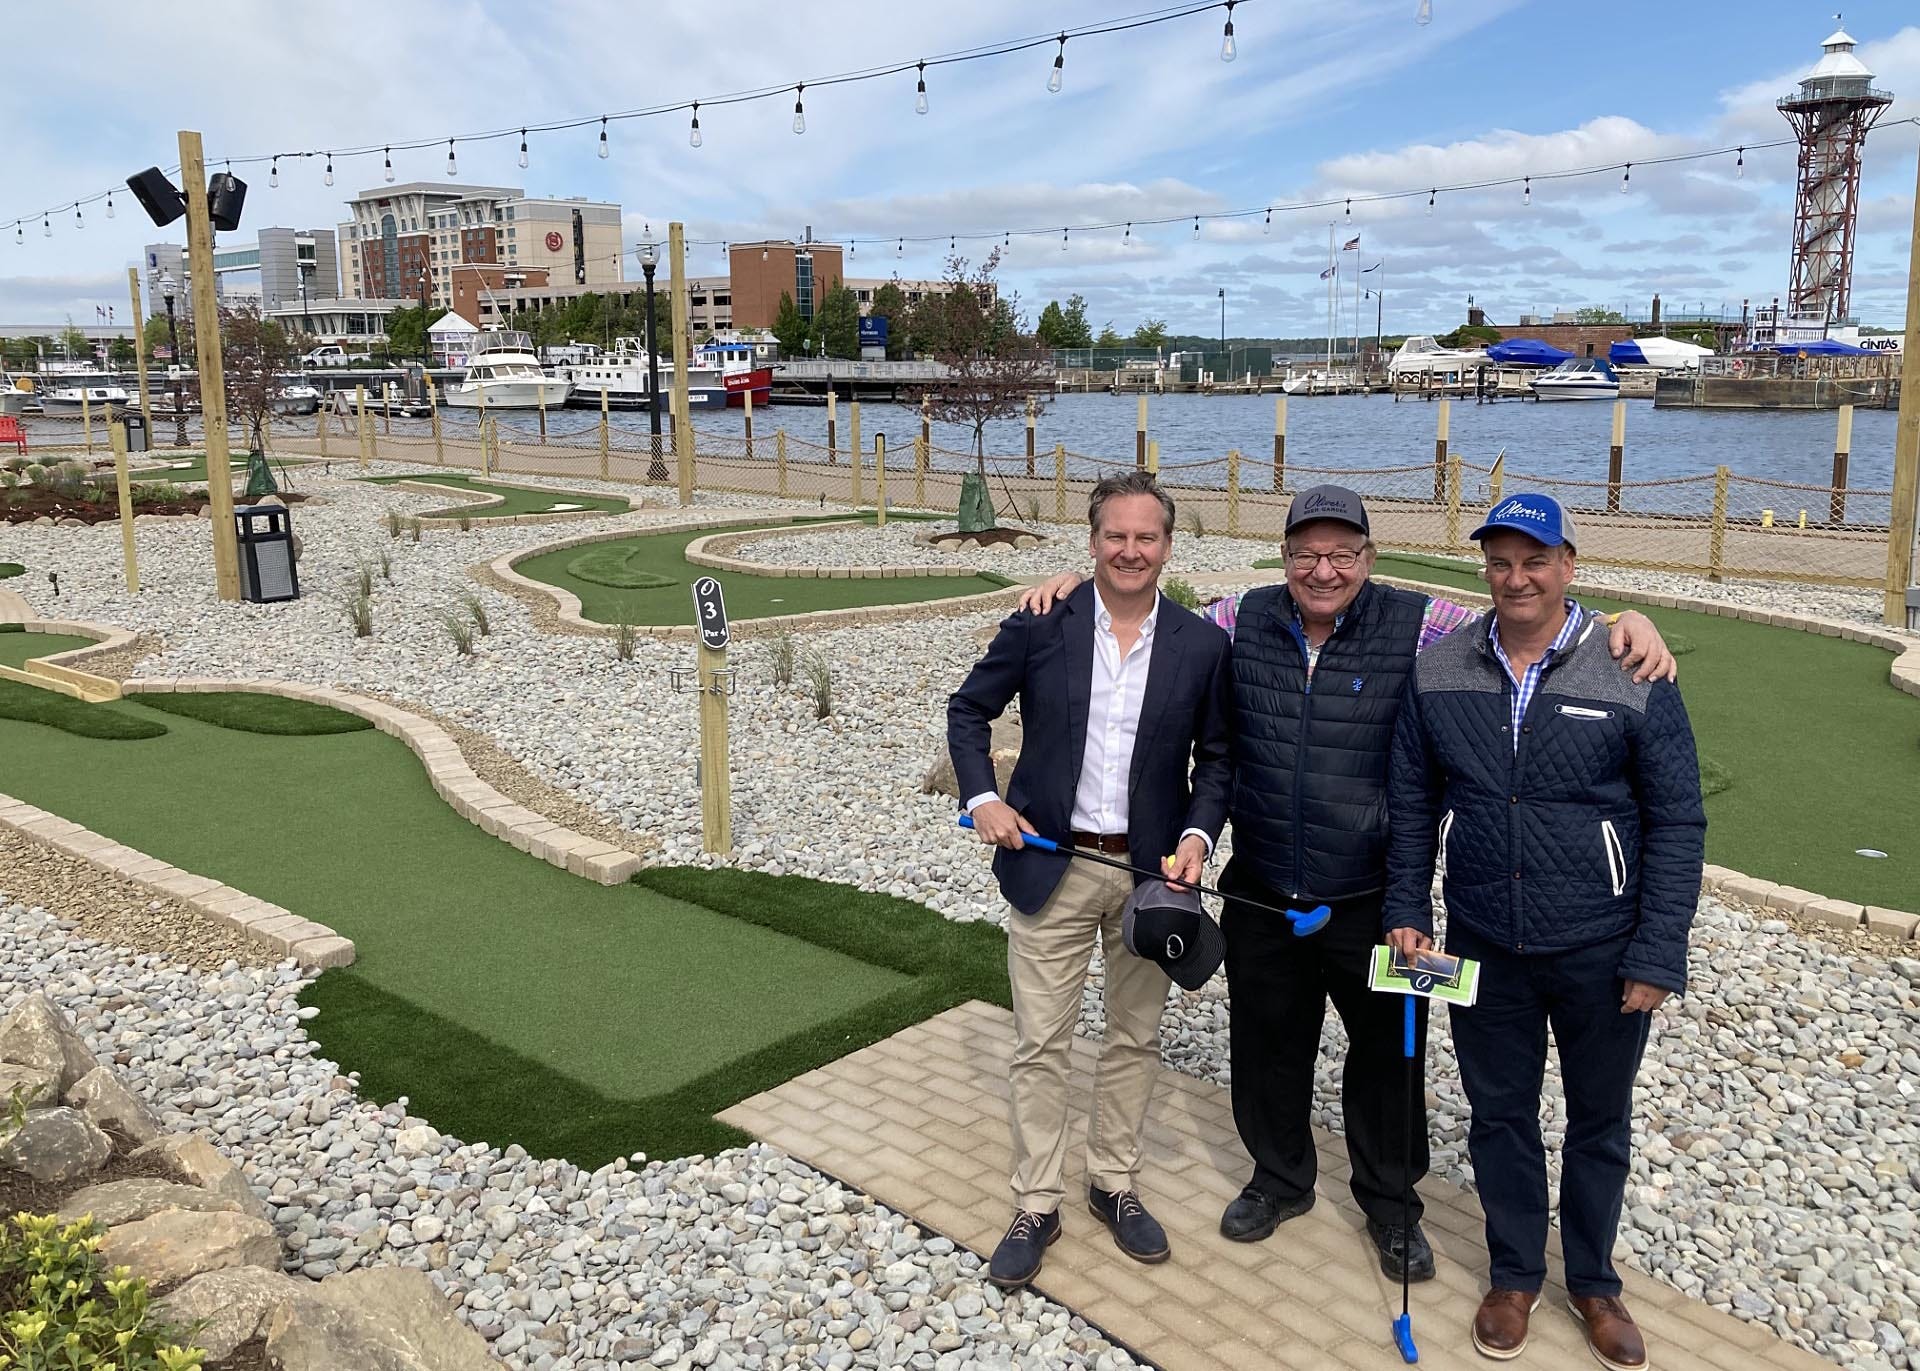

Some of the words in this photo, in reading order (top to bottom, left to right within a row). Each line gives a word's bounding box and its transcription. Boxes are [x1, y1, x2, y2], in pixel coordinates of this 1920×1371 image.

[1304, 493, 1346, 509] Oliver's
[1496, 500, 1547, 517] Oliver's
[703, 601, 718, 620] 3
[704, 629, 719, 638] Par
[720, 627, 726, 637] 4
